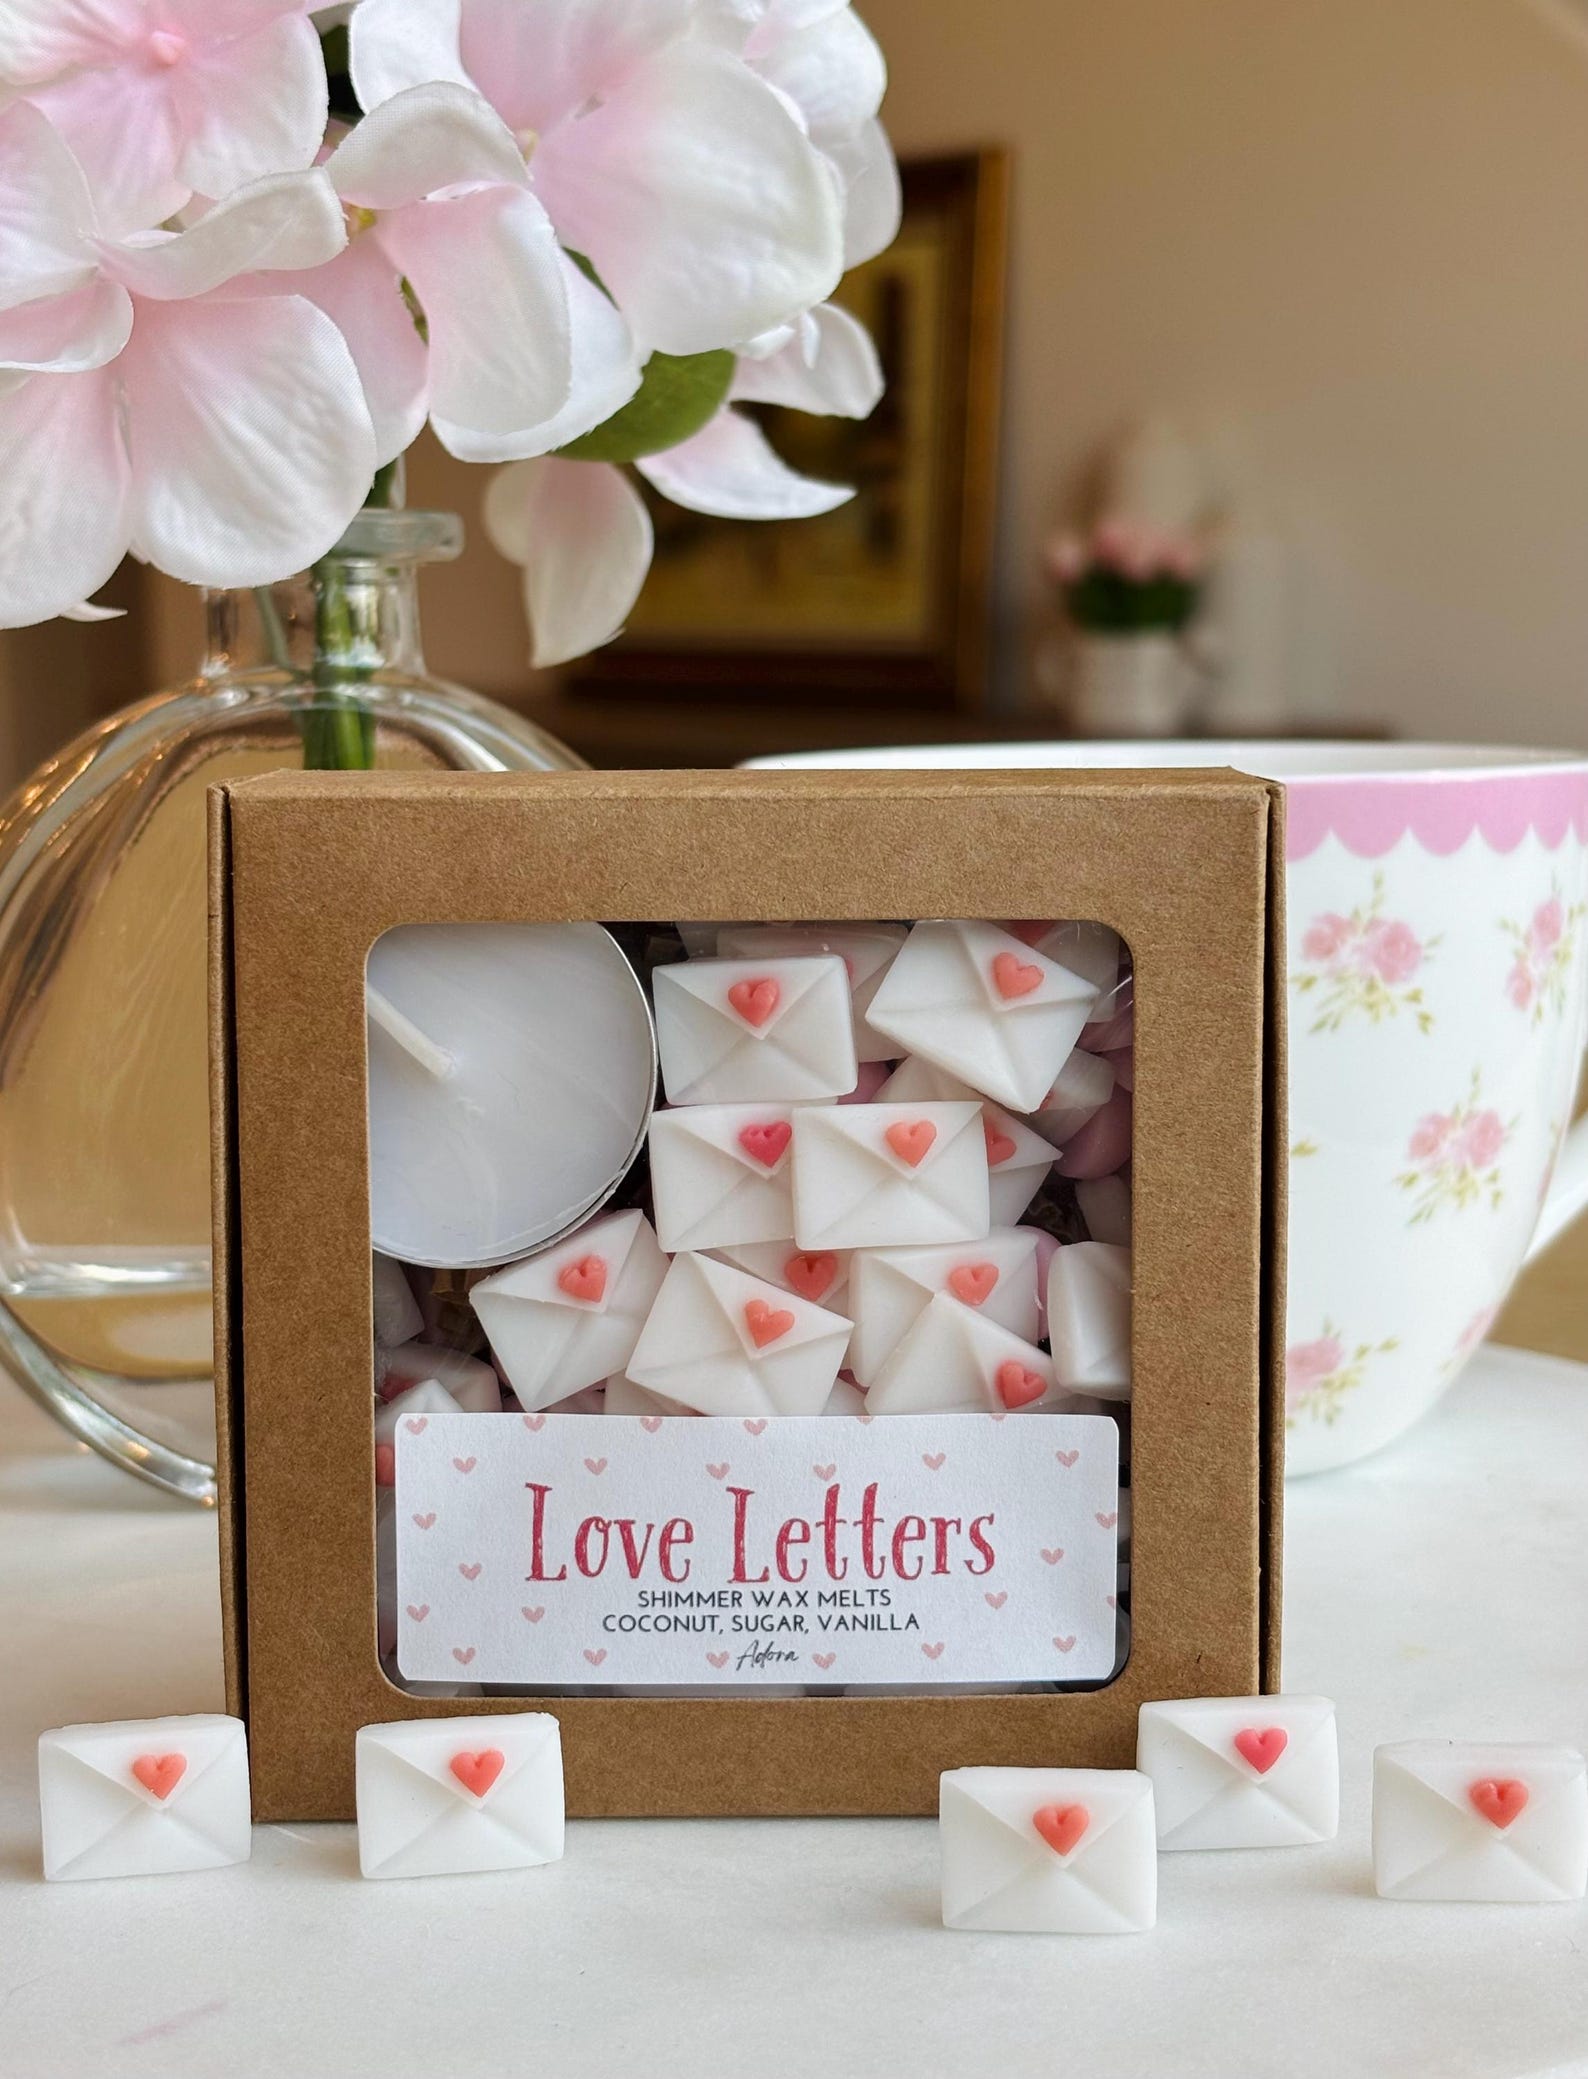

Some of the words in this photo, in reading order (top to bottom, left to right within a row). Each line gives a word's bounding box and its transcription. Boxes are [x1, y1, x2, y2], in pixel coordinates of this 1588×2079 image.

[525, 1482, 694, 1583] Love
[726, 1482, 996, 1584] Letters
[638, 1589, 743, 1608] SHIMMER
[751, 1590, 809, 1608] WAX
[817, 1589, 892, 1607] MELTS
[602, 1613, 725, 1635] COCONUT,
[731, 1613, 810, 1635] SUGAR,
[817, 1613, 920, 1632] VANILLA
